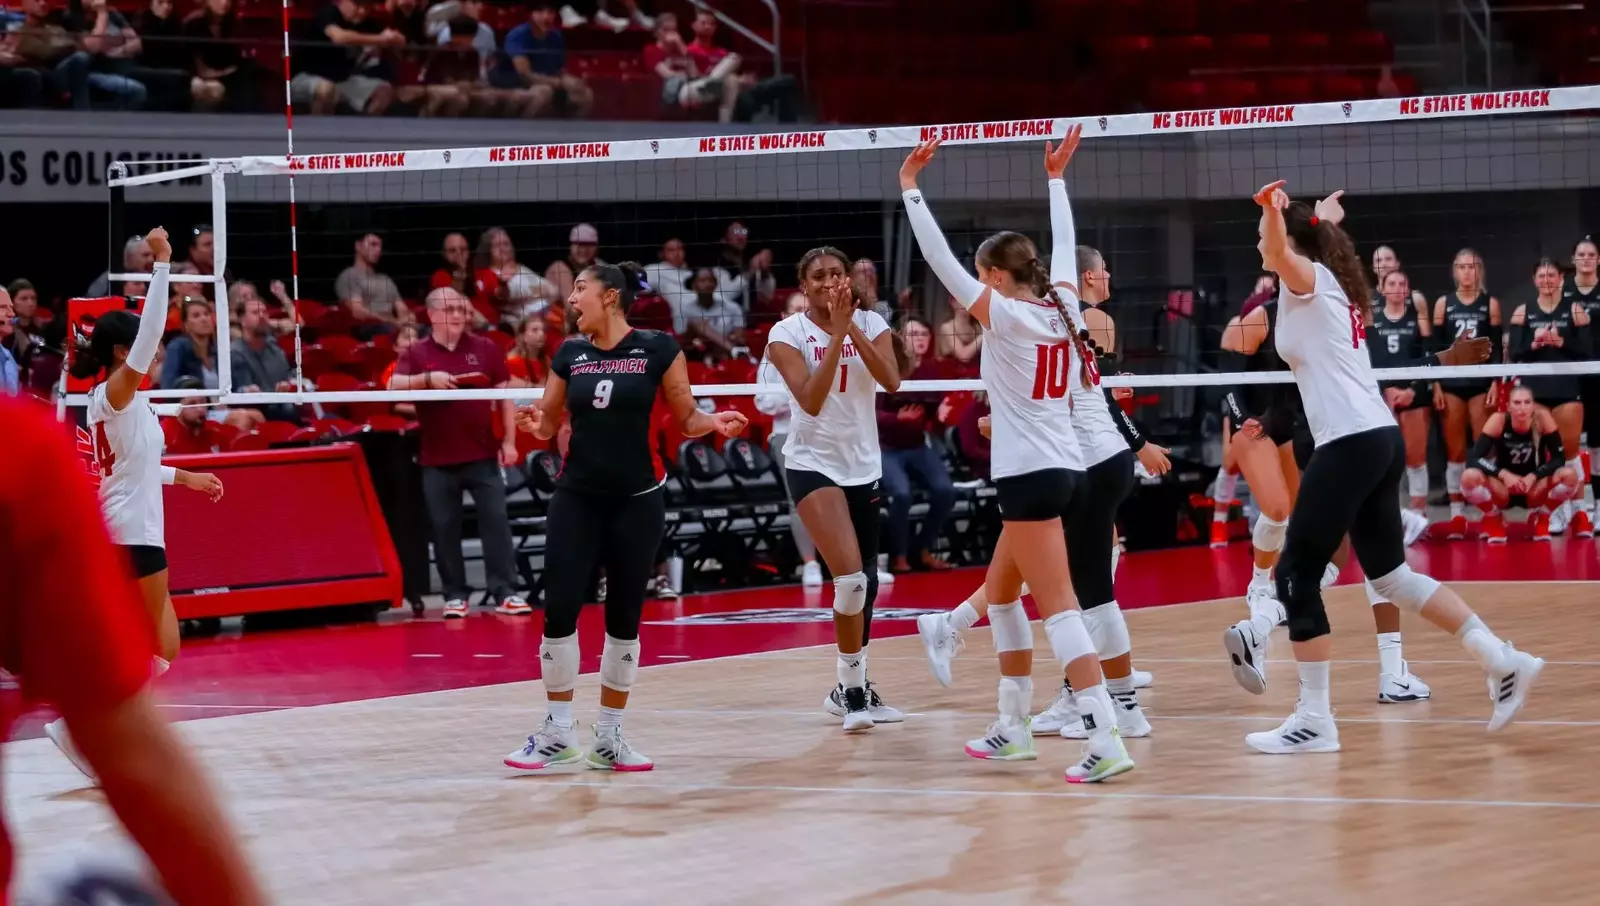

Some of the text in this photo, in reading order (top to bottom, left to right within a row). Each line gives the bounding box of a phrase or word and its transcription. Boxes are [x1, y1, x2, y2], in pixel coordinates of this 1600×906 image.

[1400, 89, 1550, 115] NC STATE WOLFPACK
[1152, 105, 1295, 129] NC STATE WOLFPACK
[920, 119, 1054, 142] NC STATE WOLFPACK
[489, 143, 610, 162] NC STATE WOLFPACK
[699, 132, 826, 152] NC STATE WOLFPACK
[0, 149, 28, 186] S
[308, 155, 341, 169] STATE
[344, 152, 406, 168] WOLFPACK
[1455, 319, 1477, 339] 25
[1387, 334, 1400, 354] 5
[570, 358, 648, 376] WOLFPACK
[1031, 340, 1070, 400] 10
[839, 364, 848, 393] 1
[592, 379, 614, 409] 9
[1510, 448, 1533, 464] 27
